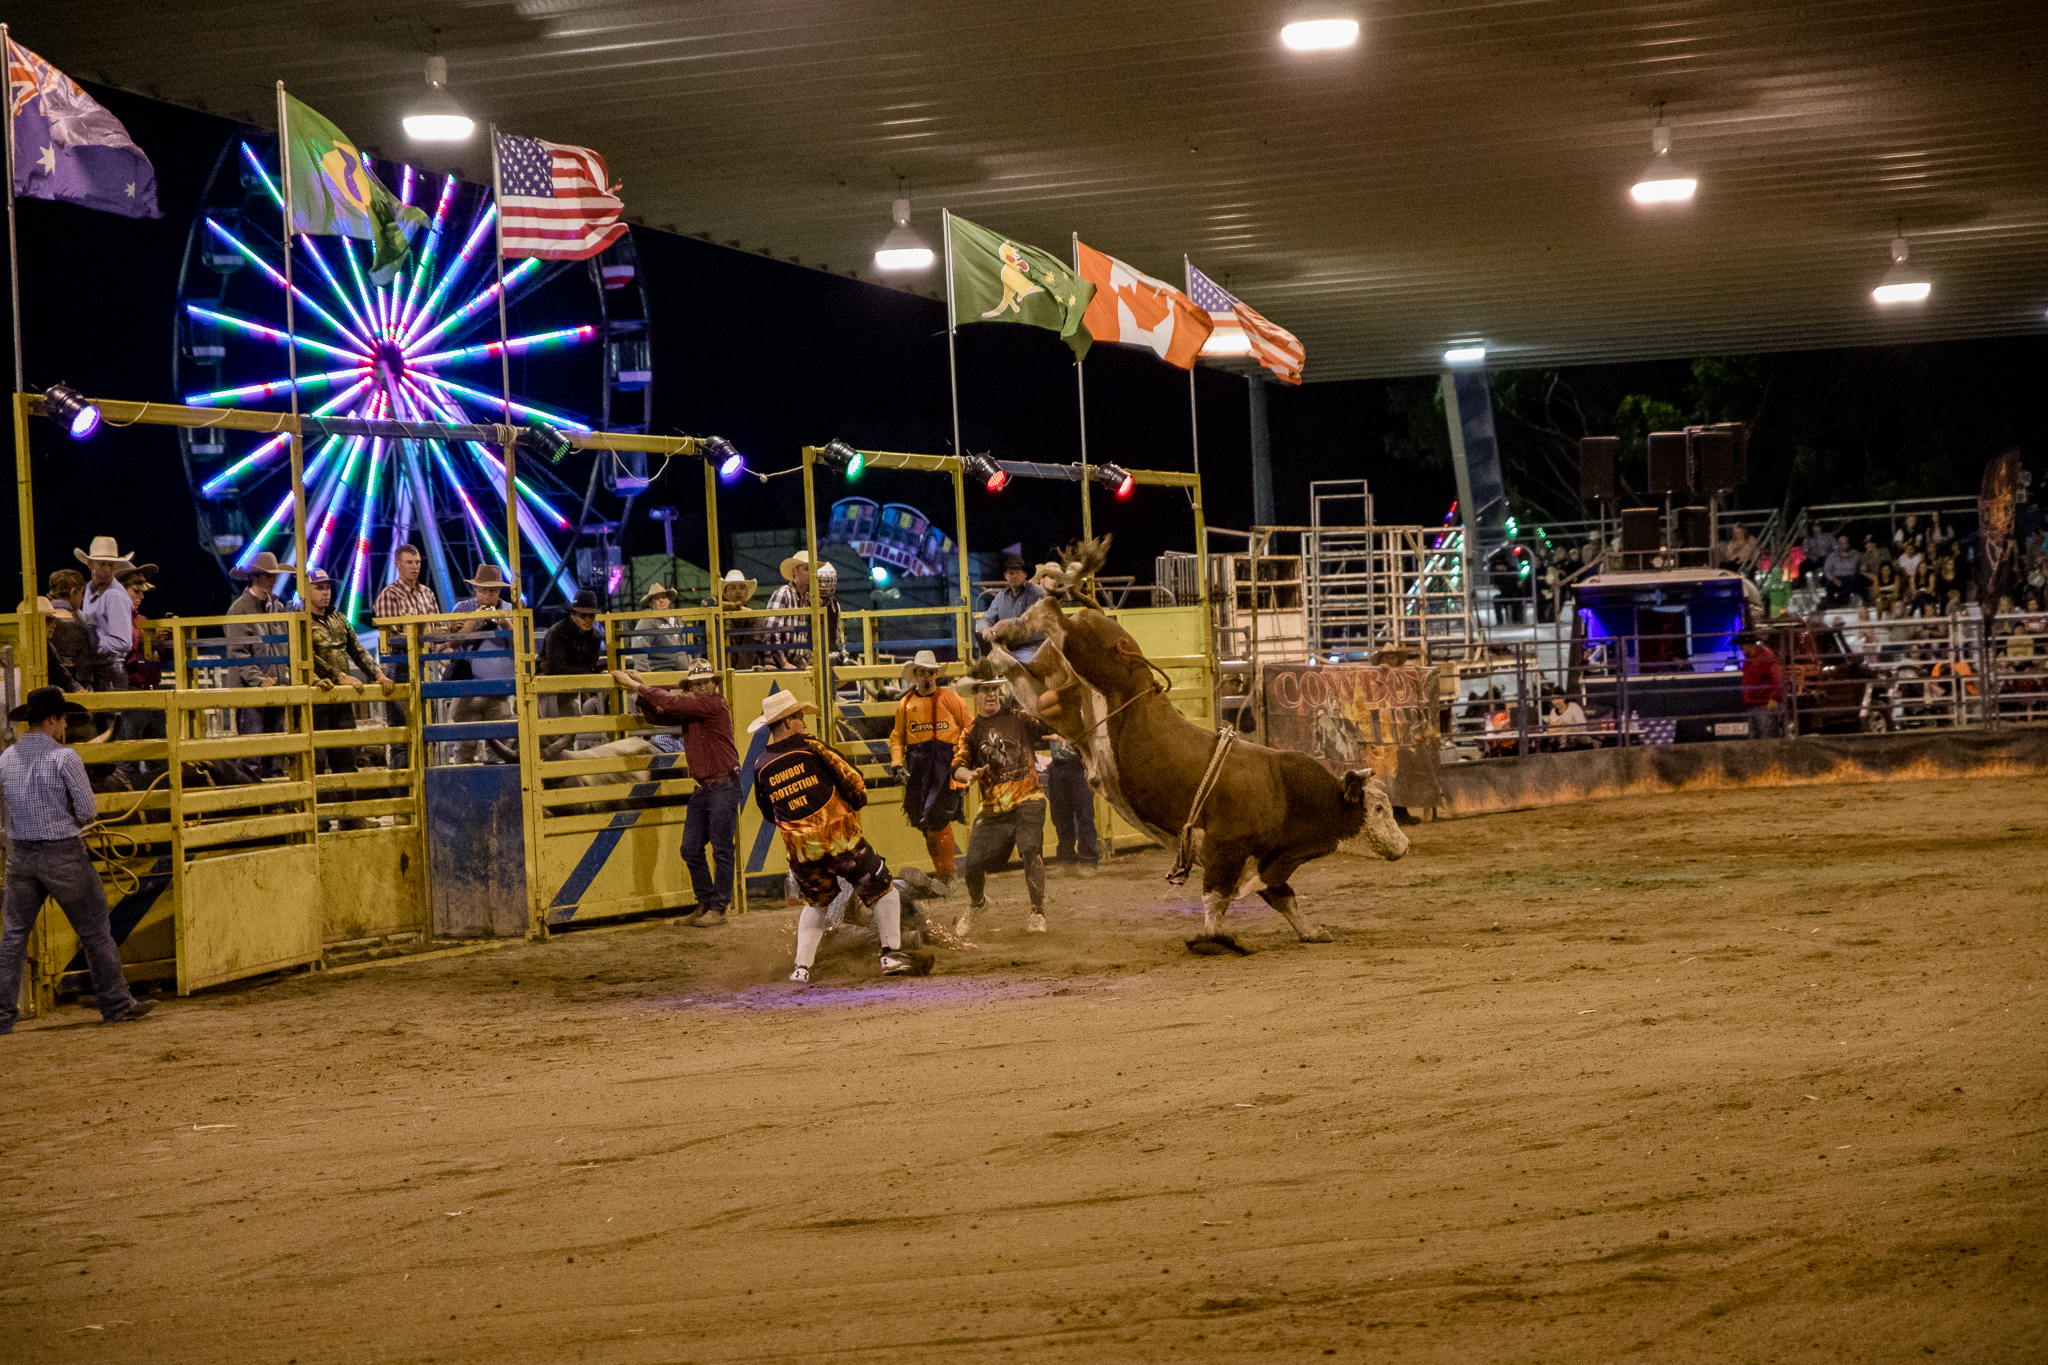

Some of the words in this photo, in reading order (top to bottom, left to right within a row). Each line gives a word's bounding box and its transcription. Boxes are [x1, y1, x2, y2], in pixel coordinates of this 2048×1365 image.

[1274, 670, 1433, 709] COWBOY
[769, 762, 805, 787] COWBOY
[769, 774, 819, 804] PROTECTION
[787, 794, 809, 811] UNIT
